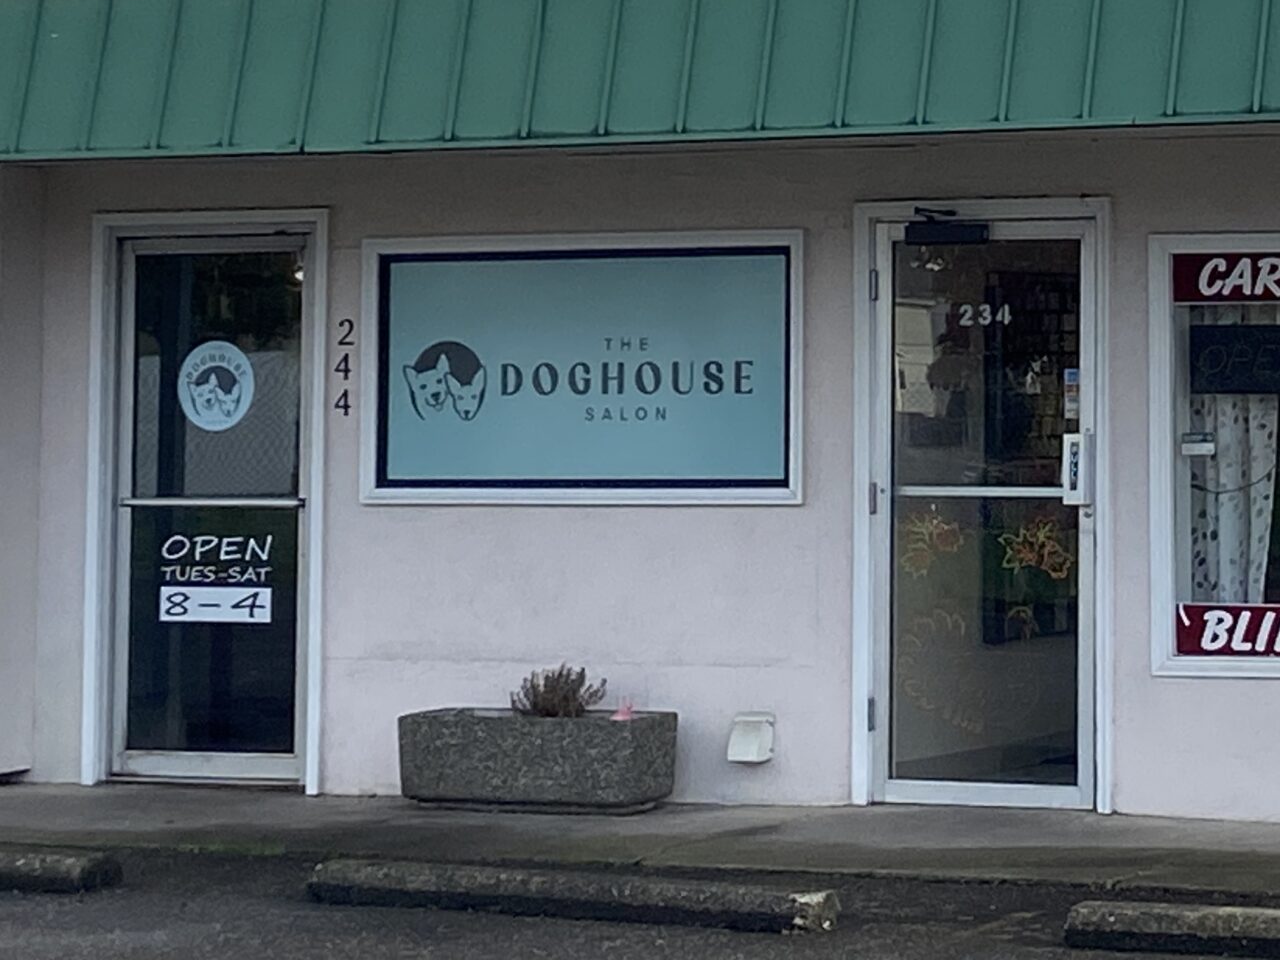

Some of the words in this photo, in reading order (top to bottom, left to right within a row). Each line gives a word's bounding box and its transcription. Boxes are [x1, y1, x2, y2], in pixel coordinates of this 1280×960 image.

[958, 303, 1013, 326] 234
[604, 338, 649, 351] THE
[500, 360, 754, 396] DOGHOUSE
[585, 407, 669, 422] SALON
[161, 534, 273, 561] OPEN
[160, 566, 273, 582] TUES-SAT
